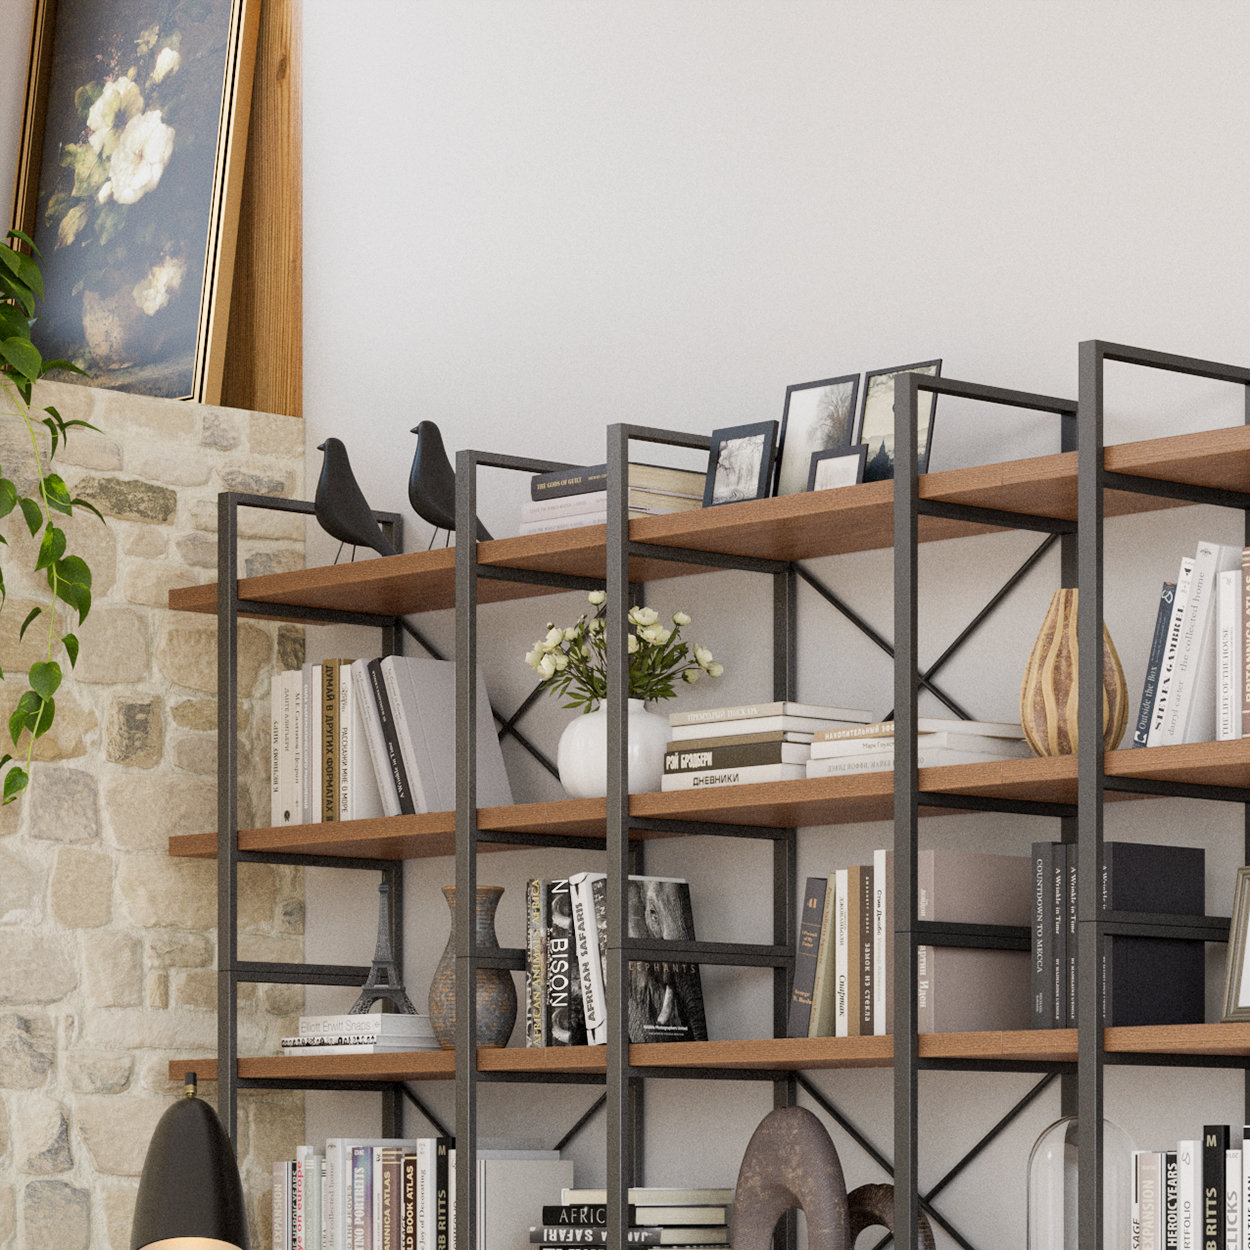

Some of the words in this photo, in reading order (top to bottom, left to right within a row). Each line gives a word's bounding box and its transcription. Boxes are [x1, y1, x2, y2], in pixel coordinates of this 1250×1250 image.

[325, 665, 335, 701] ДУМАЙ
[1144, 684, 1155, 698] the
[1146, 665, 1158, 682] Box
[1139, 699, 1152, 730] Outside
[325, 715, 335, 755] ДРУГИХ
[325, 758, 335, 812] ФОРМАТАХ
[693, 773, 740, 786] ДНЕВНИКИ
[532, 879, 542, 925] AFRICA
[1036, 858, 1044, 923] COUNTDOWN
[1036, 924, 1044, 937] TO
[532, 929, 542, 988] ANIMALS
[550, 938, 569, 1007] BISON
[864, 942, 872, 972] замок
[1036, 939, 1044, 973] MECCA
[532, 990, 542, 1046] AFRICAN
[864, 989, 872, 1022] стекла
[406, 1165, 414, 1200] ATLAS
[1168, 1162, 1178, 1201] YEARS
[406, 1202, 414, 1234] BOOK
[438, 1189, 447, 1232] RITTS
[559, 1208, 606, 1223] AFRIC
[1168, 1202, 1178, 1247] HEROIC
[1206, 1187, 1217, 1237] RITTS
